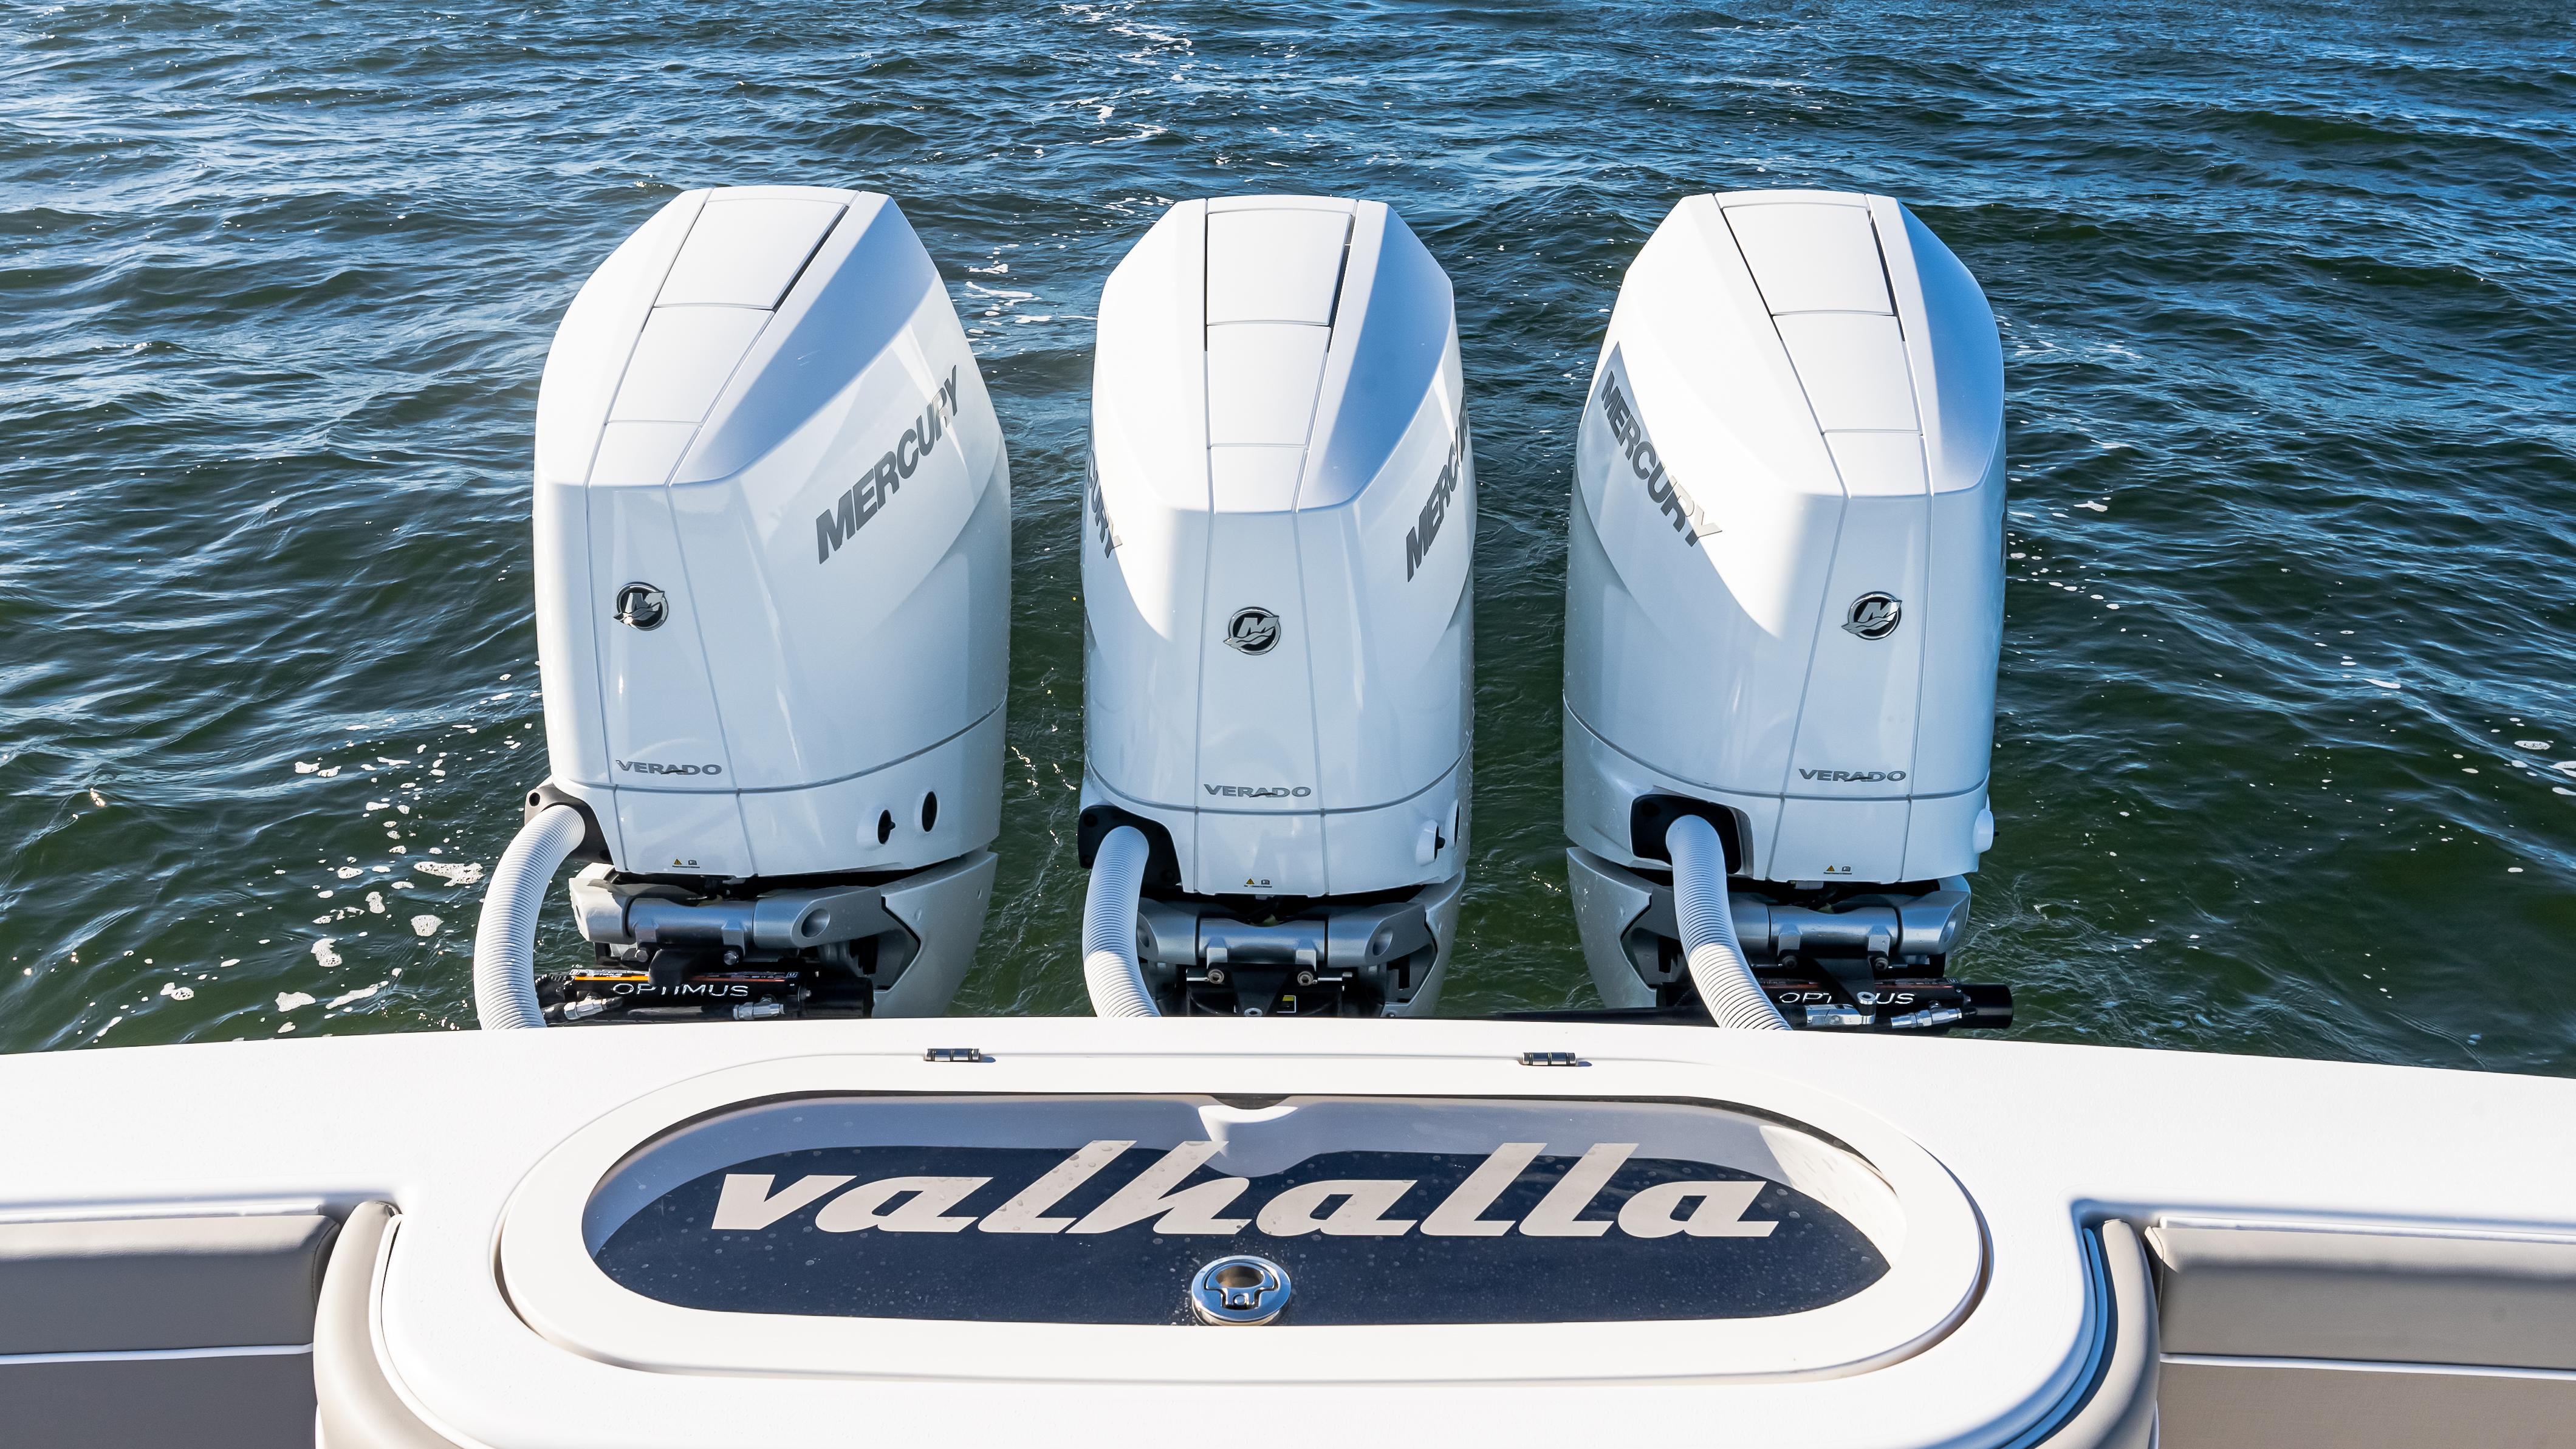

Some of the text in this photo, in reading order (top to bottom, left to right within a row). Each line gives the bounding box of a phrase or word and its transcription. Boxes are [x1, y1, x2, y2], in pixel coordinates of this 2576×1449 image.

[815, 365, 958, 565] MERCURY
[1087, 428, 1123, 559] CURY
[1406, 387, 1469, 583] MERCUR
[1600, 370, 1723, 547] MERCURY
[615, 759, 722, 775] VERADO
[1203, 783, 1312, 798] VERADO
[1798, 768, 1906, 783] VERADO
[1779, 992, 1915, 1004] OPTUS
[711, 1140, 1780, 1239] valhalla
